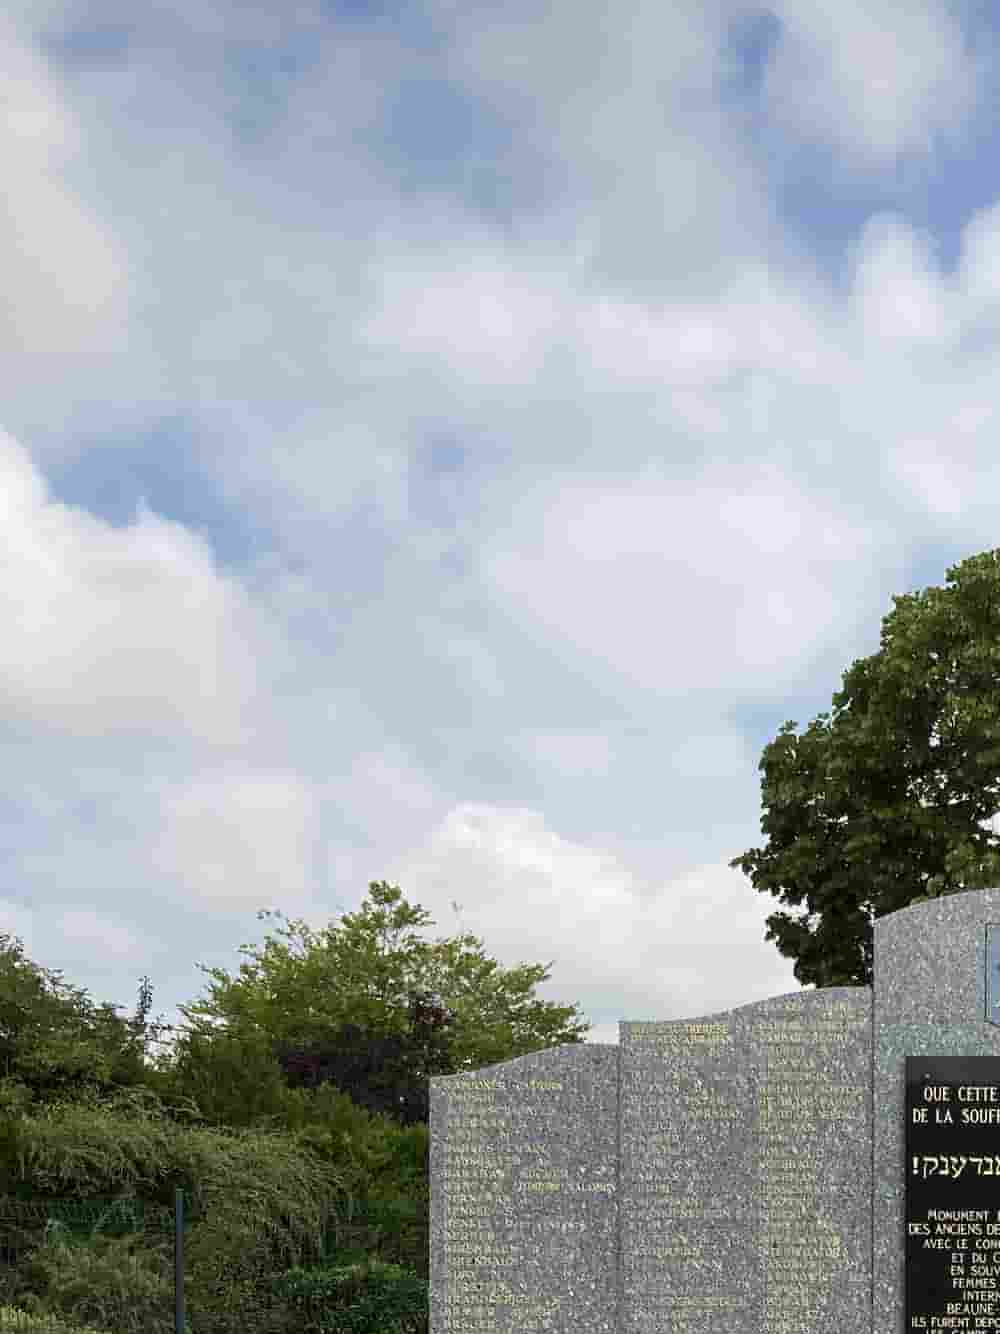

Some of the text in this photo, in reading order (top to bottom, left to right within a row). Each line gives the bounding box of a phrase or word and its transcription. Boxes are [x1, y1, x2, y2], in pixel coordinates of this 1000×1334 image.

[923, 1086, 950, 1102] QUE
[957, 1086, 998, 1102] CETTE
[912, 1108, 929, 1123] DE
[935, 1109, 954, 1123] LA
[927, 1209, 990, 1222] MONUMENT
[935, 1223, 983, 1236] ANCIENS
[923, 1237, 951, 1250] AVEC
[956, 1238, 969, 1250] LE
[951, 1252, 964, 1264] ET
[971, 1251, 987, 1264] DU
[950, 1264, 965, 1277] EN
[952, 1277, 997, 1289] FEMMES
[911, 1316, 927, 1328] ILS
[930, 1316, 970, 1329] FURENT
